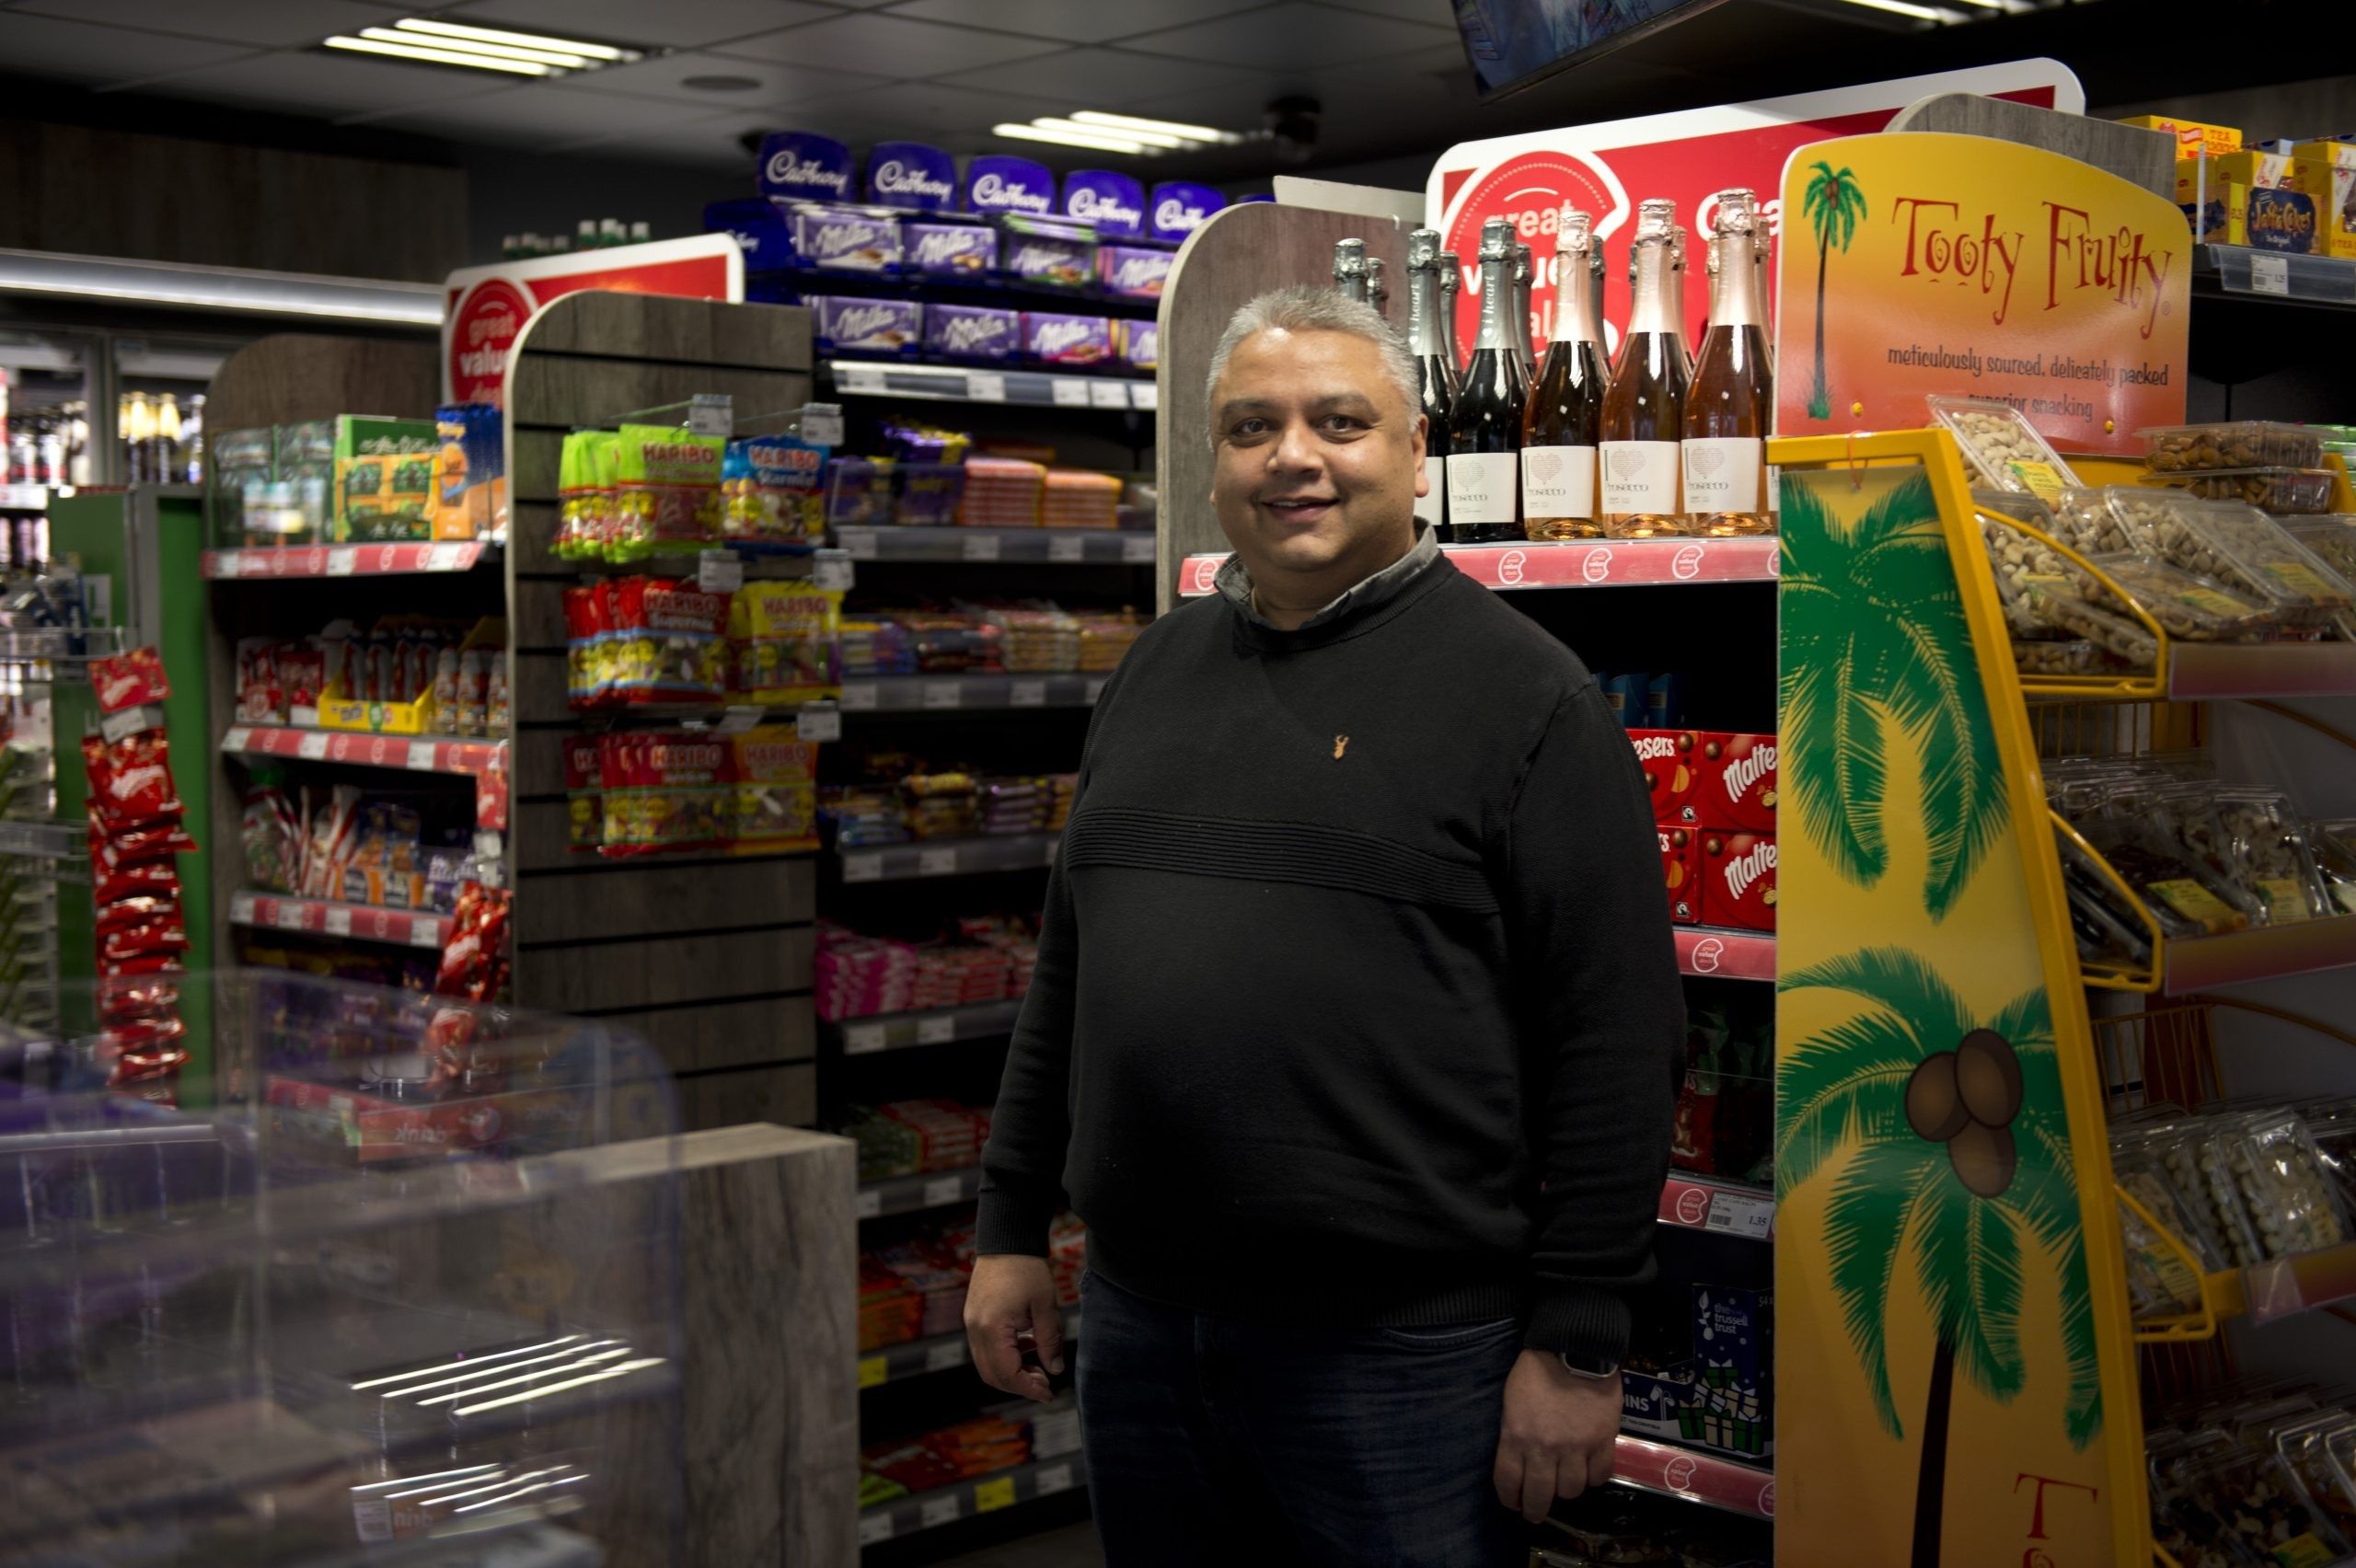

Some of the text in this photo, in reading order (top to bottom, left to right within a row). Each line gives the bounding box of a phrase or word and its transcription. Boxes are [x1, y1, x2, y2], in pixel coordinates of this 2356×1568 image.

[766, 149, 849, 195] Cadbury
[874, 159, 953, 202] Cadbury
[972, 172, 1051, 213] Cadbury
[1068, 187, 1143, 231] Cadbury
[911, 228, 976, 264] Milka
[1892, 198, 2172, 340] Tooty Fruity
[1030, 319, 1091, 353] Milka
[1888, 344, 1982, 377] meticulously
[2050, 355, 2115, 387] delicately
[2119, 362, 2169, 387] packed
[2032, 394, 2093, 423] snacking
[642, 442, 716, 465] HARIBO
[748, 447, 821, 471] HARIBO
[762, 594, 828, 617] HARIBO
[649, 744, 722, 770] HARIBO
[745, 743, 811, 764] HARIBO
[1723, 744, 1777, 804] Malte
[1724, 840, 1777, 901] Malte
[1748, 1215, 1768, 1227] 1.35
[1714, 1313, 1749, 1328] trussell
[1714, 1323, 1738, 1335] trust
